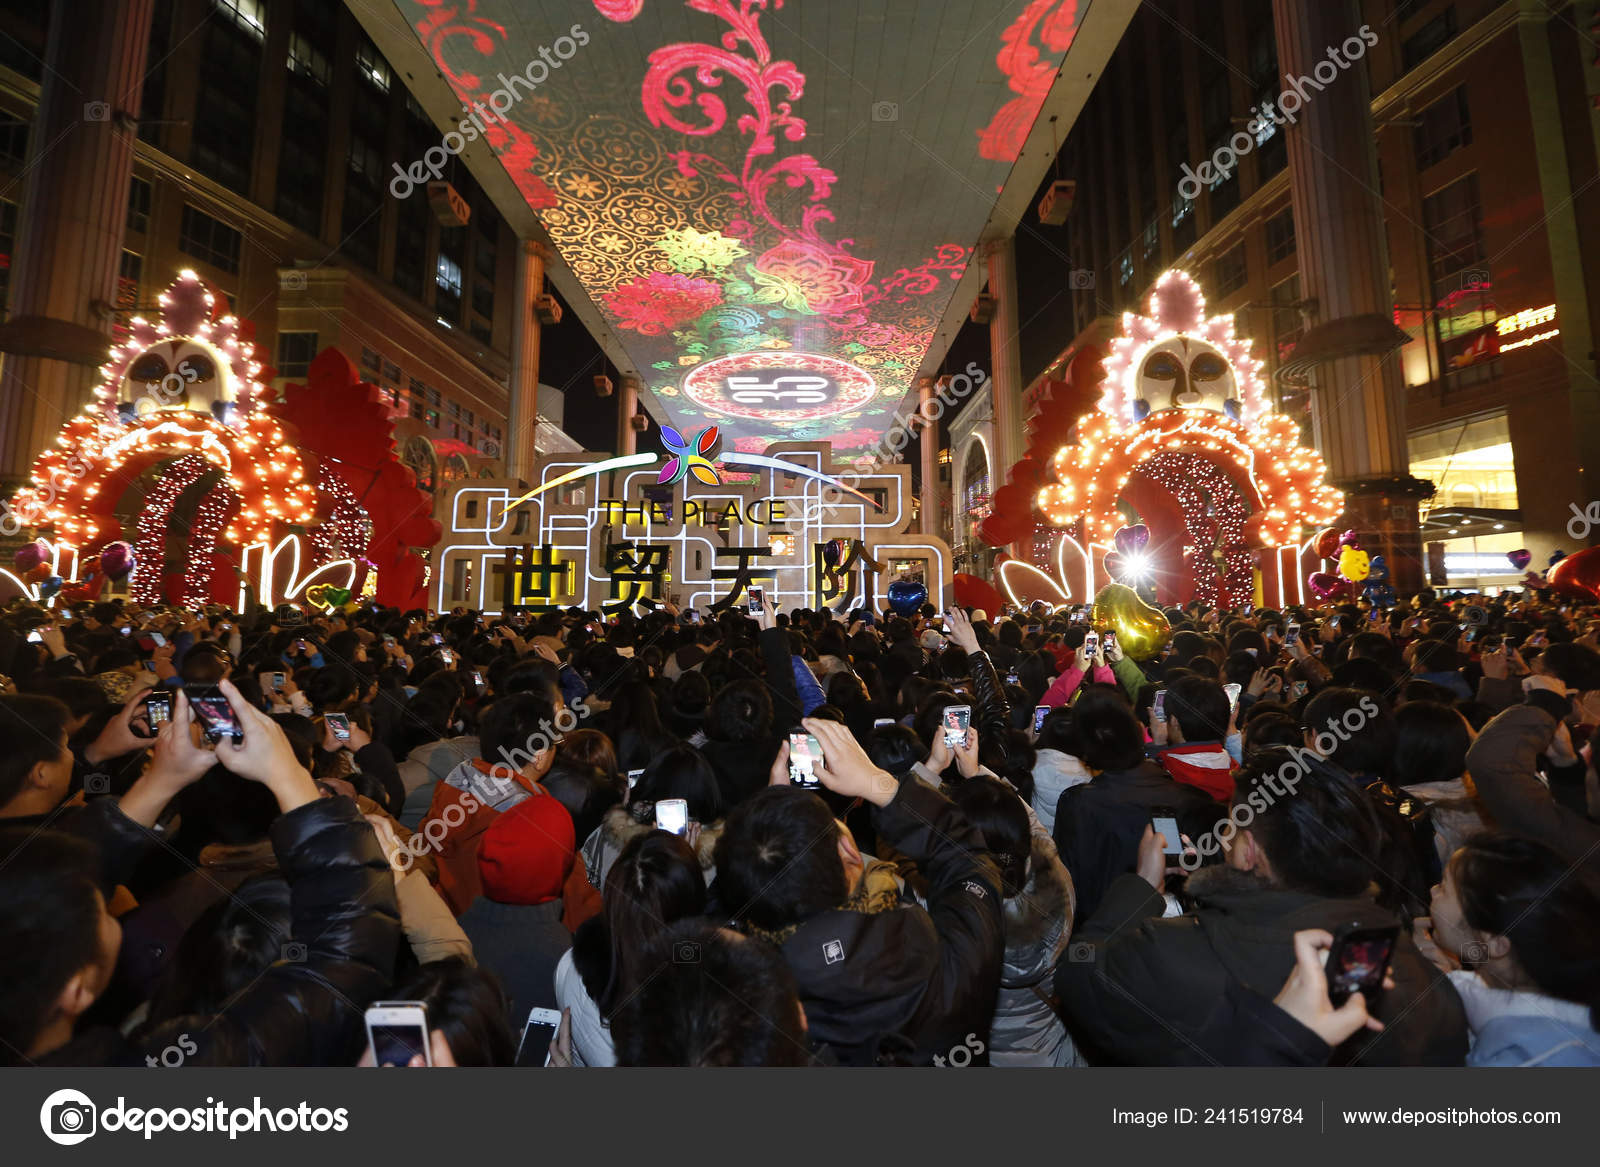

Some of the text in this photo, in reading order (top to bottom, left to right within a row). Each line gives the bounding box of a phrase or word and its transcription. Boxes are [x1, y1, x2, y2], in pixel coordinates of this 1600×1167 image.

[599, 500, 786, 525] THE PLACE
[492, 539, 887, 615] 世贸天阶
